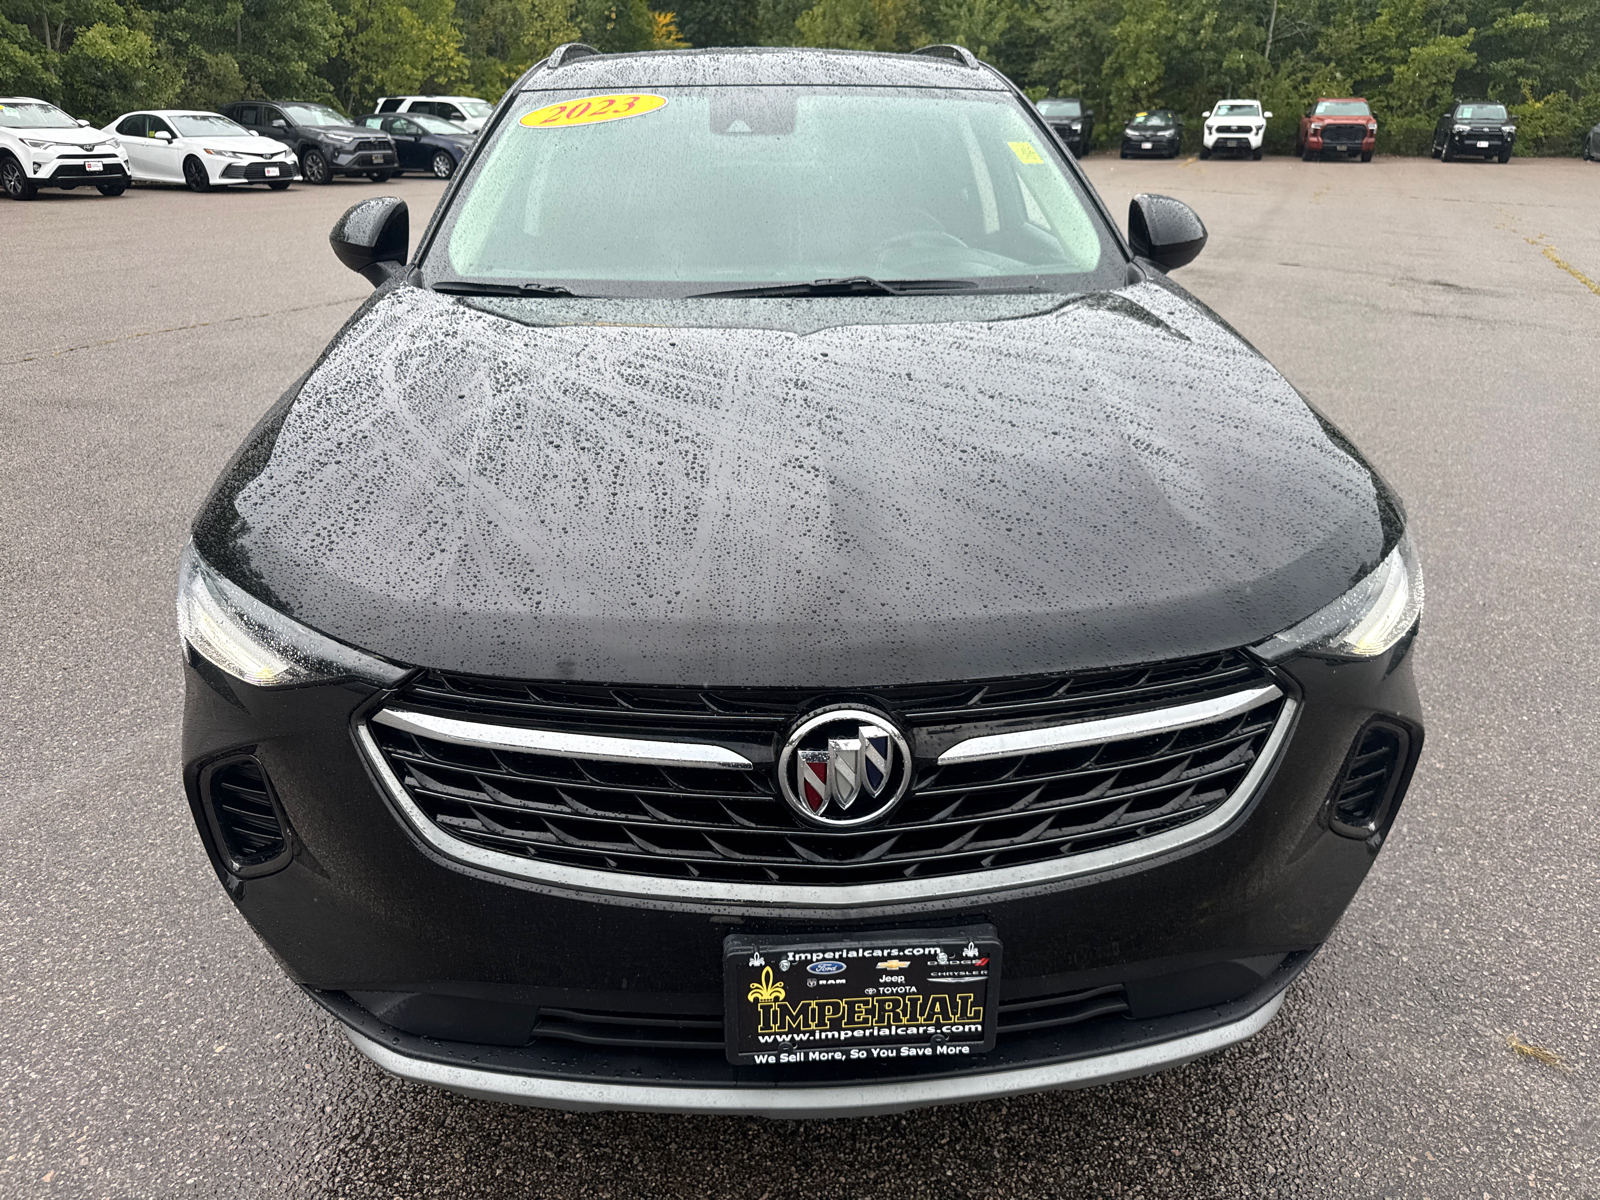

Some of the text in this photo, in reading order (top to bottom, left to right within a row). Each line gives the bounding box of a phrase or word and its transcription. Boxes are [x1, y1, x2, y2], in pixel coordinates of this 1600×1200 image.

[539, 96, 641, 125] 2023
[787, 947, 941, 962] Imperialcars.com
[815, 963, 837, 972] Ford
[879, 975, 905, 983] Jeep
[878, 986, 917, 994] TOYOTA
[758, 993, 983, 1033] IMPERIAL
[758, 1024, 982, 1043] www.imperialcars.com
[754, 1045, 970, 1064] We Sell More, So You Save More
